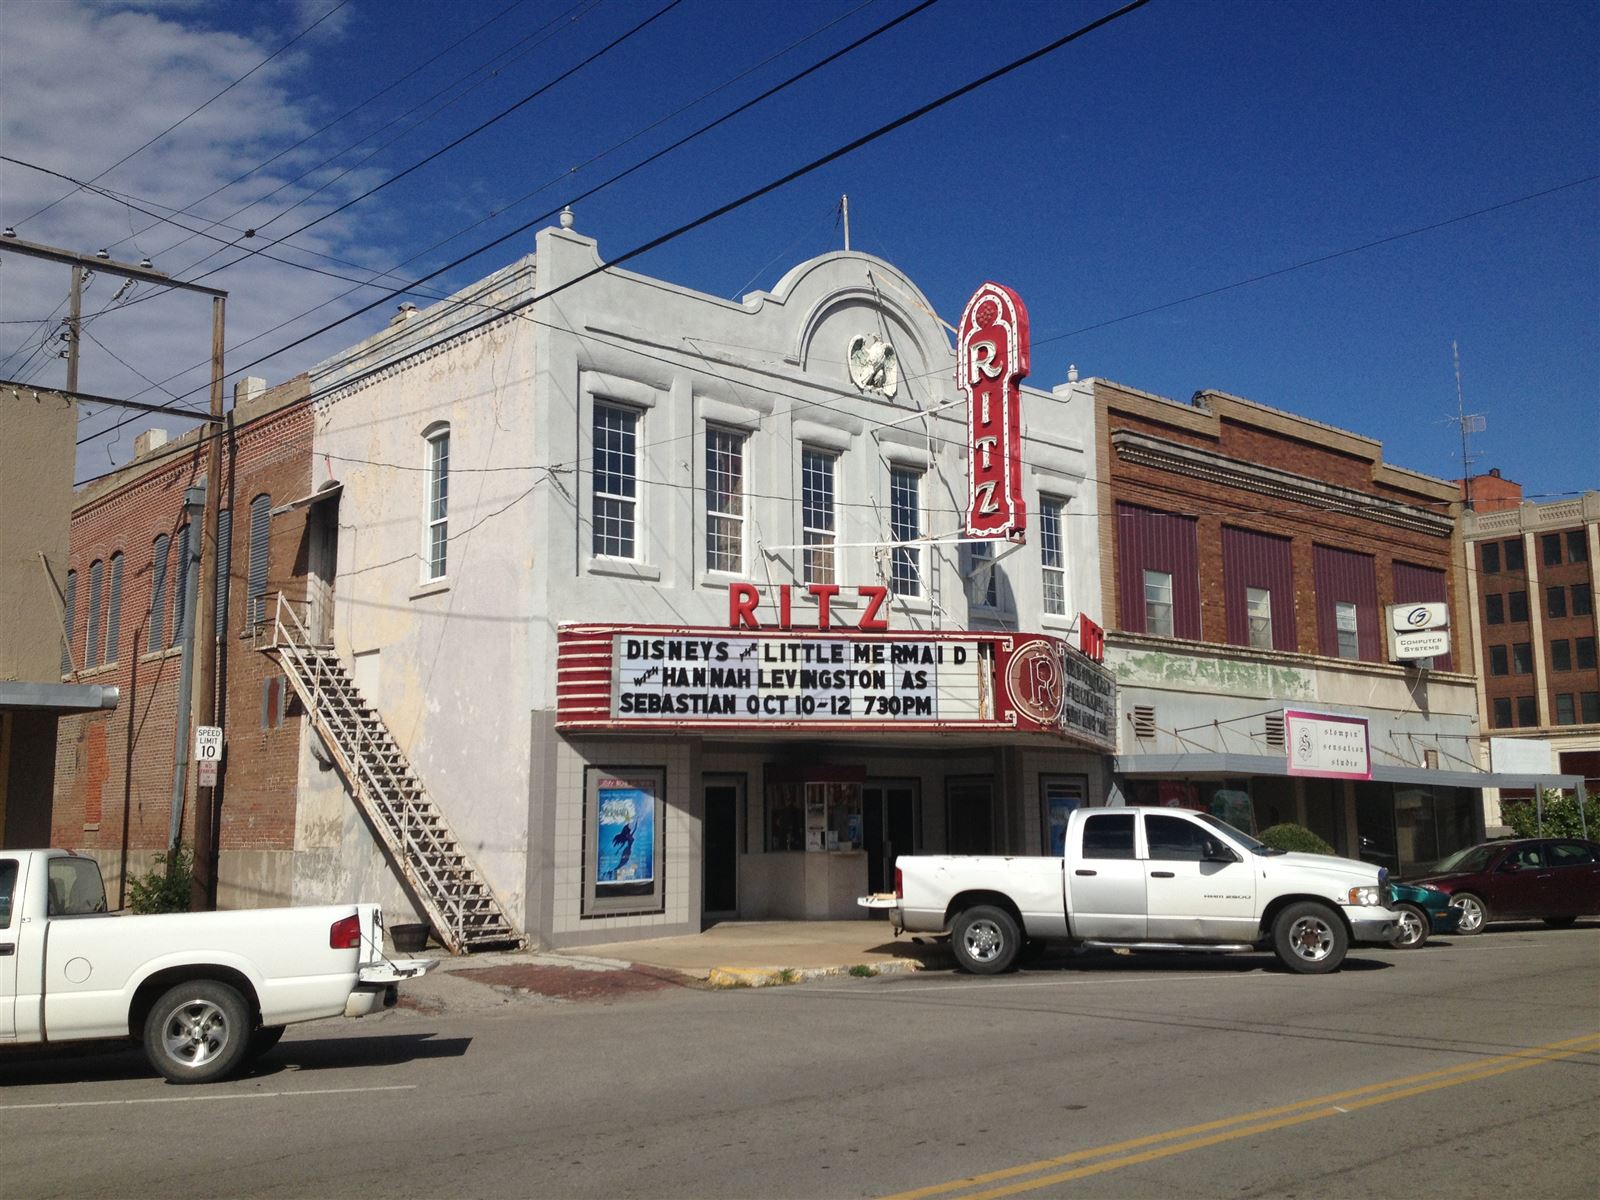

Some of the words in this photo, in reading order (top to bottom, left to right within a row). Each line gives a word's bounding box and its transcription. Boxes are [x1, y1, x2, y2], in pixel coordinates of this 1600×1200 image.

[969, 340, 1003, 515] RITZ
[729, 582, 889, 631] RITZ
[627, 640, 729, 662] DISNEYS
[739, 643, 757, 661] THE
[764, 643, 844, 663] LITTLE
[662, 667, 750, 689] HANNAH
[758, 669, 885, 690] LEVINGSTON
[901, 670, 928, 690] AS
[619, 692, 736, 714] SEBASTIAN
[746, 695, 789, 715] OCT
[796, 695, 850, 715] 10-12
[864, 695, 932, 716] 730PM
[198, 729, 221, 737] SPEED
[202, 745, 215, 758] 10
